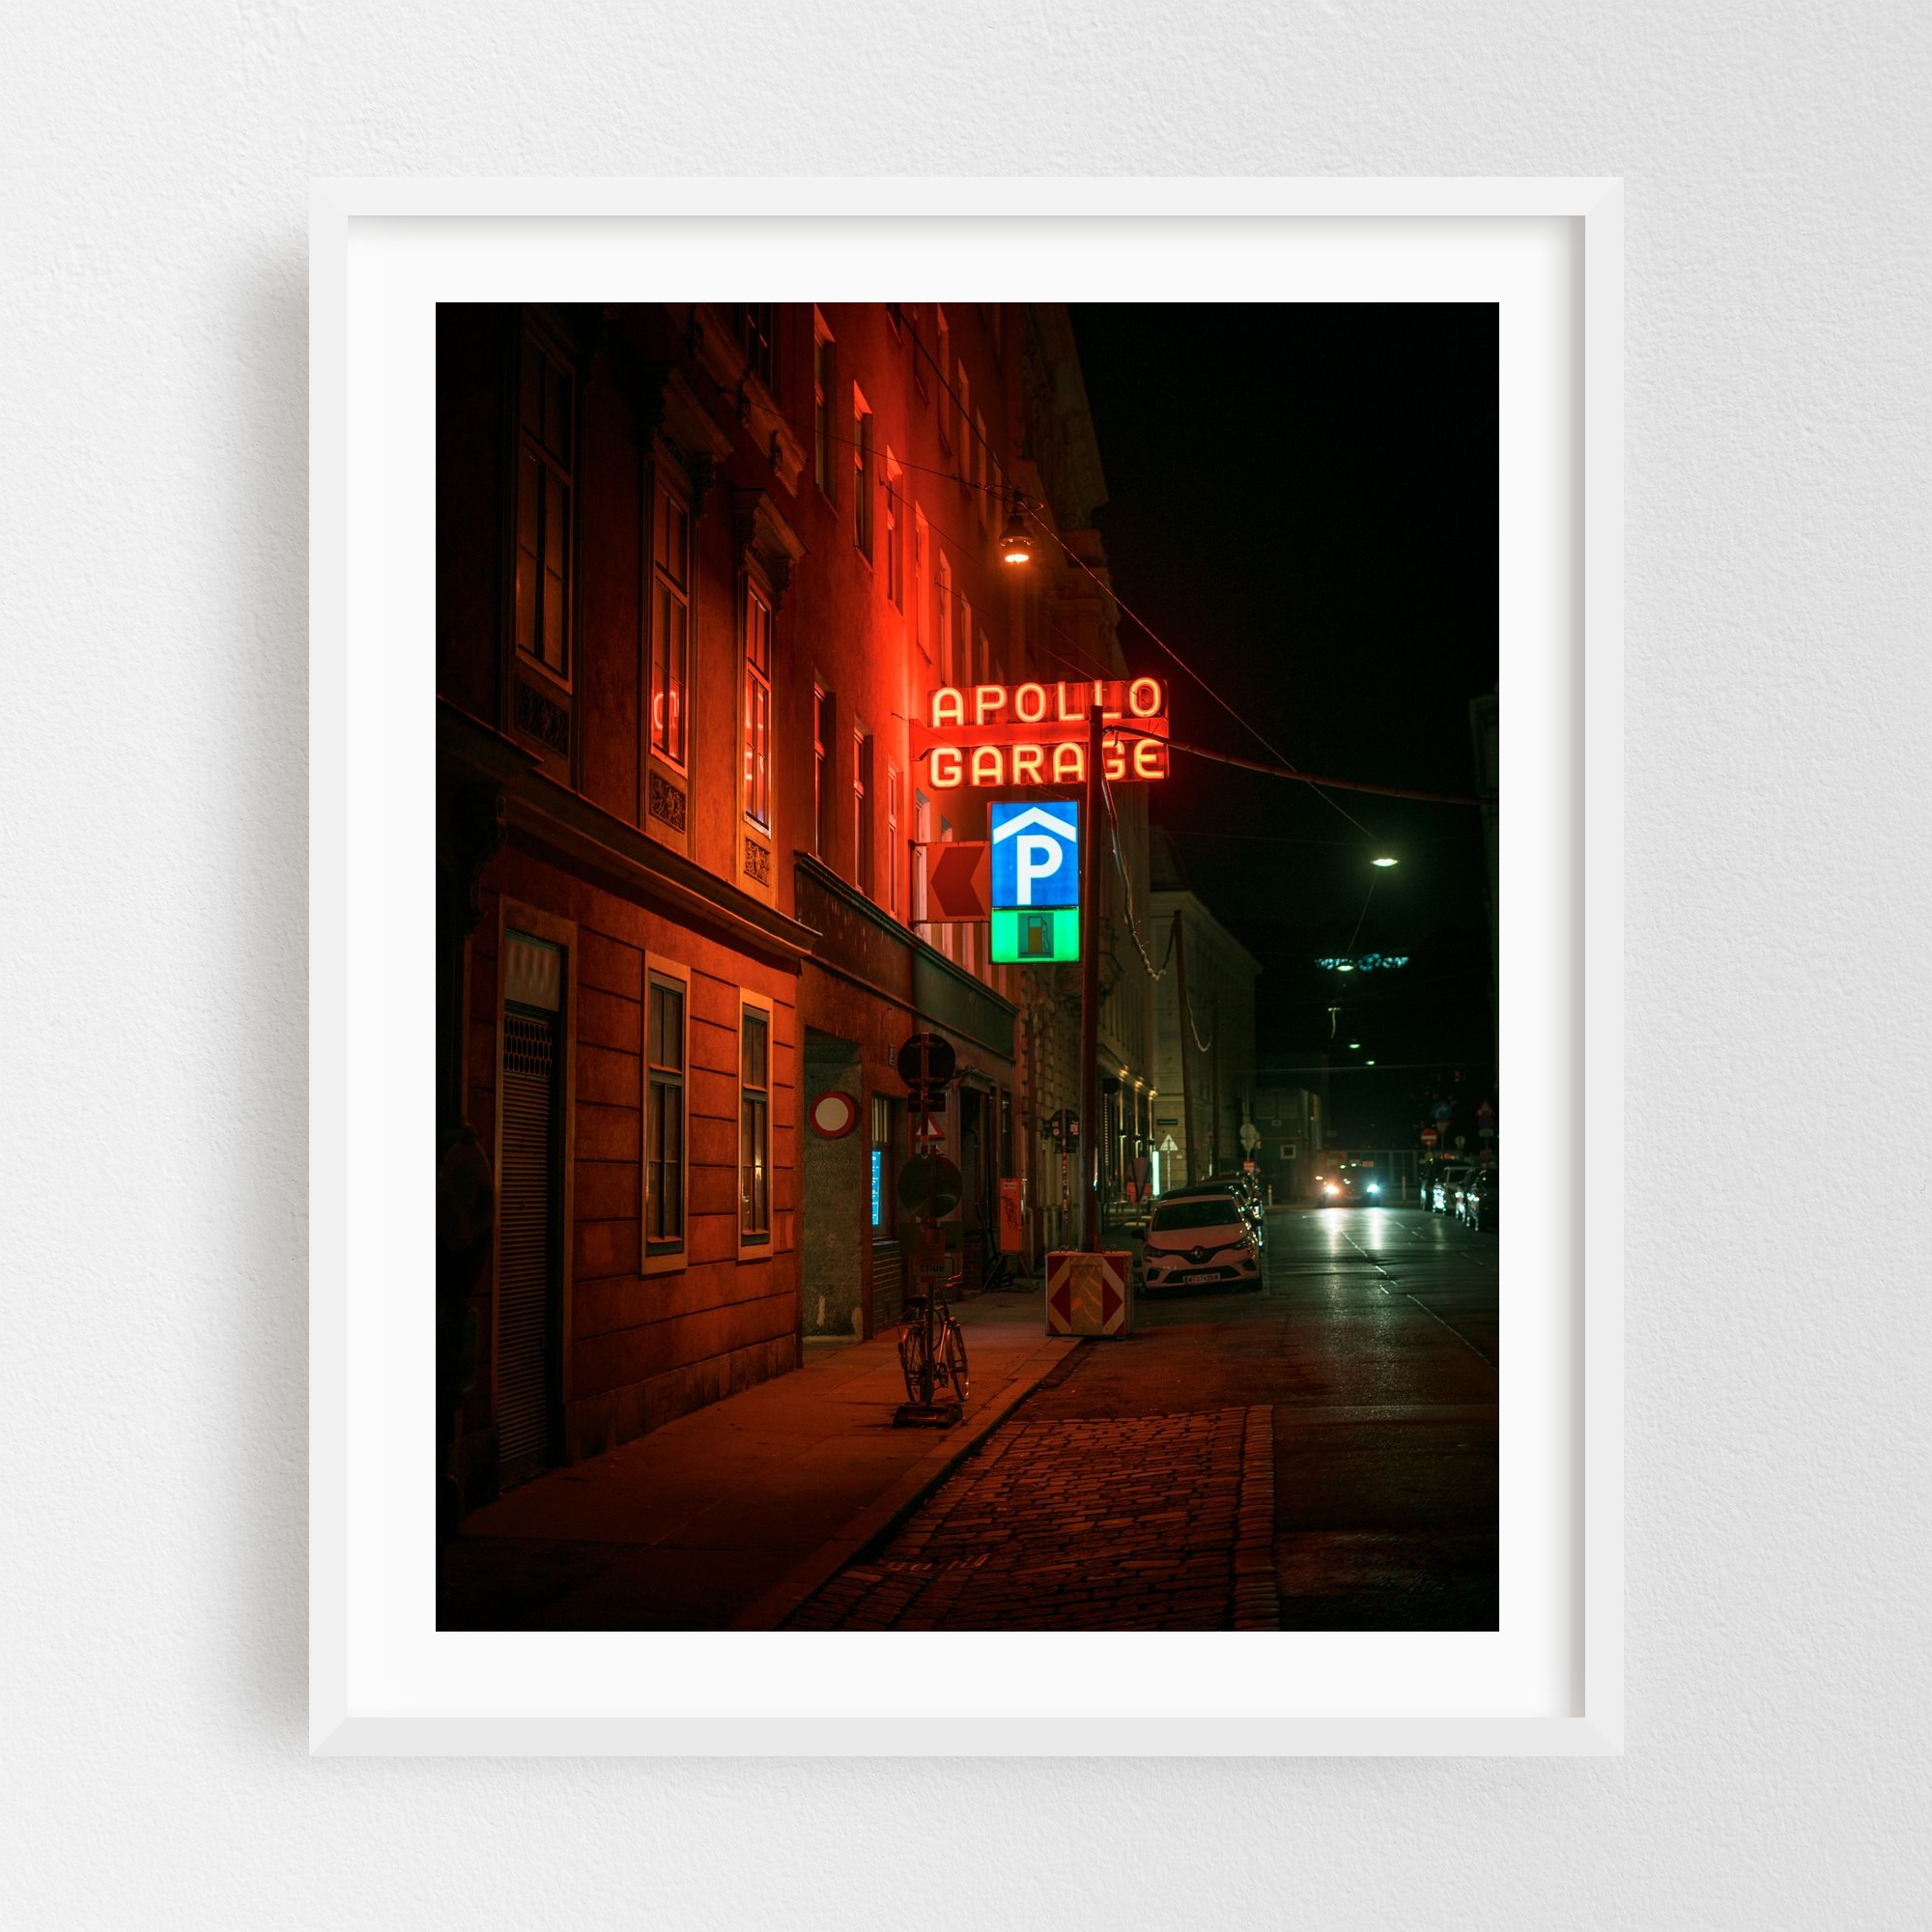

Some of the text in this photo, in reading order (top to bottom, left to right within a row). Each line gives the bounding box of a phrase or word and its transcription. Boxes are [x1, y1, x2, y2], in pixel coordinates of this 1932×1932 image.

[932, 677, 1161, 727] APOLLO
[930, 739, 1165, 787] GARAGE
[1017, 835, 1063, 905] P
